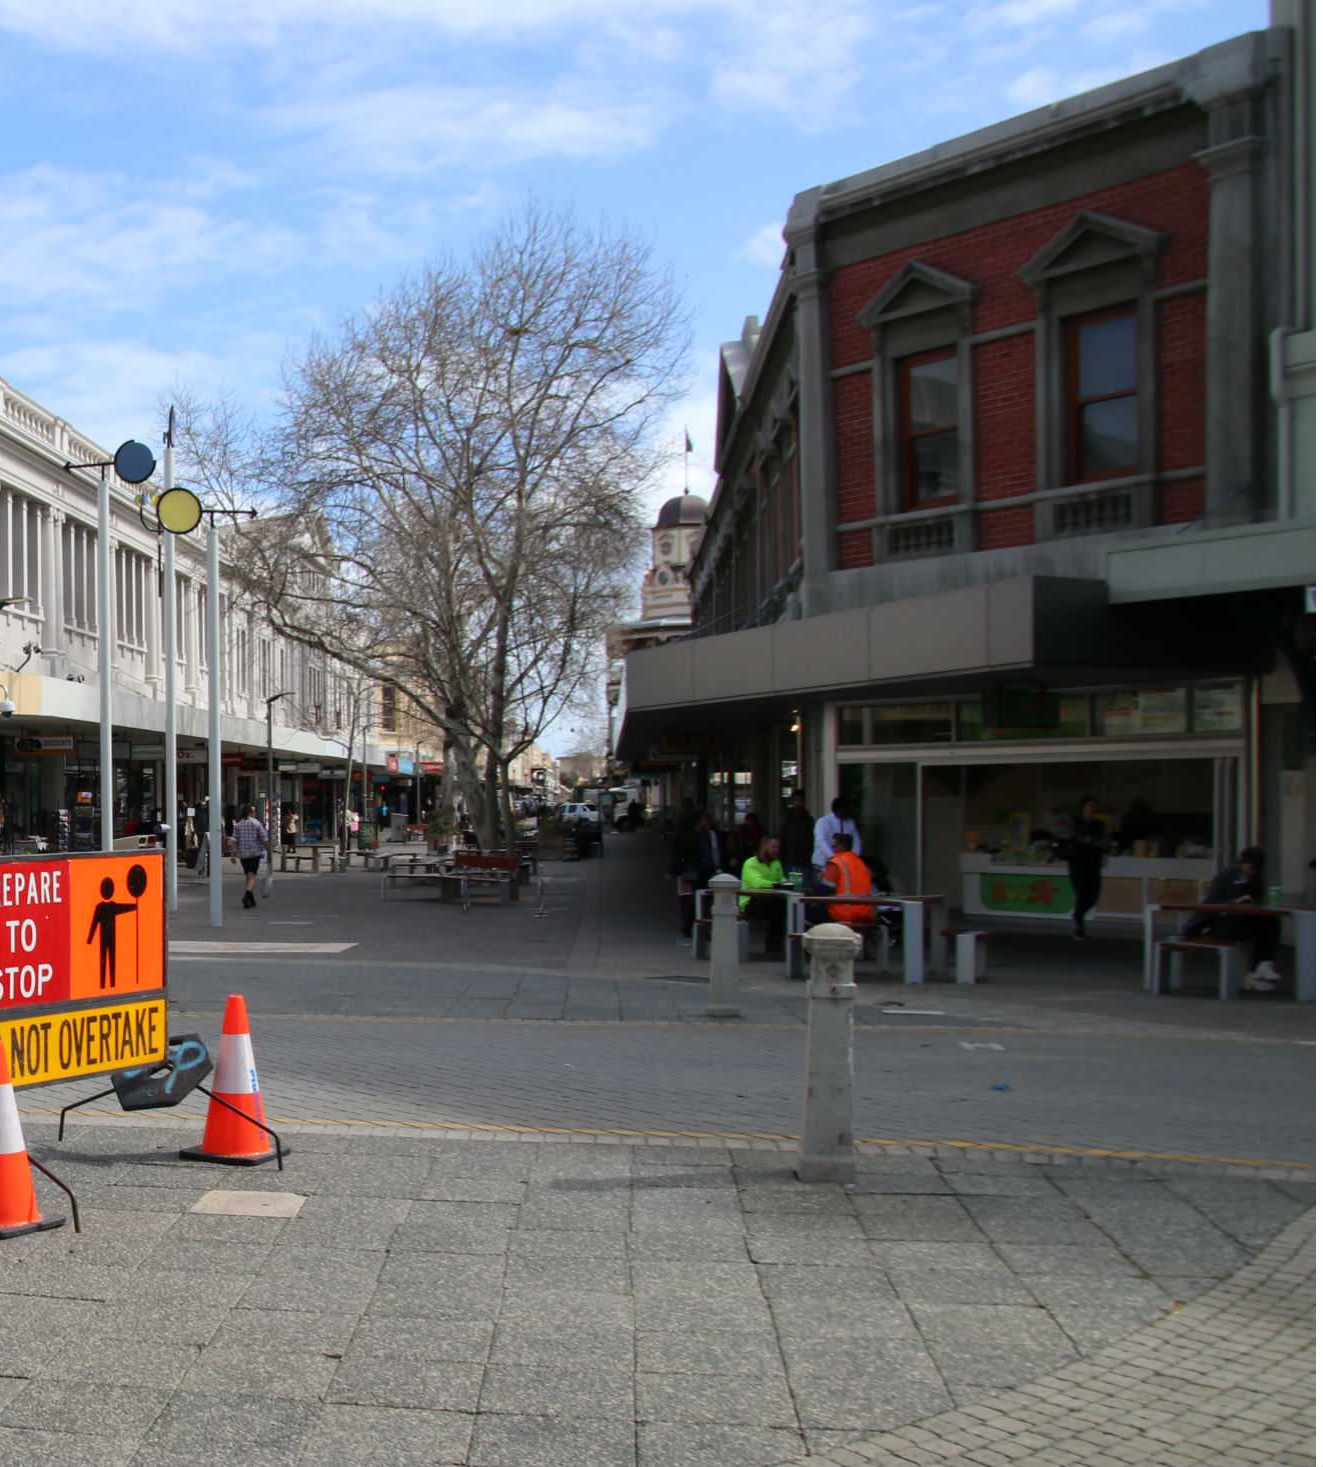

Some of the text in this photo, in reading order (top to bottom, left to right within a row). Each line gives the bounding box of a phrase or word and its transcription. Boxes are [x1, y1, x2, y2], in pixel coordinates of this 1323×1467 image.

[5, 918, 37, 953] TO
[10, 1022, 52, 1080] NOT
[59, 1006, 160, 1070] OVERTAKE
